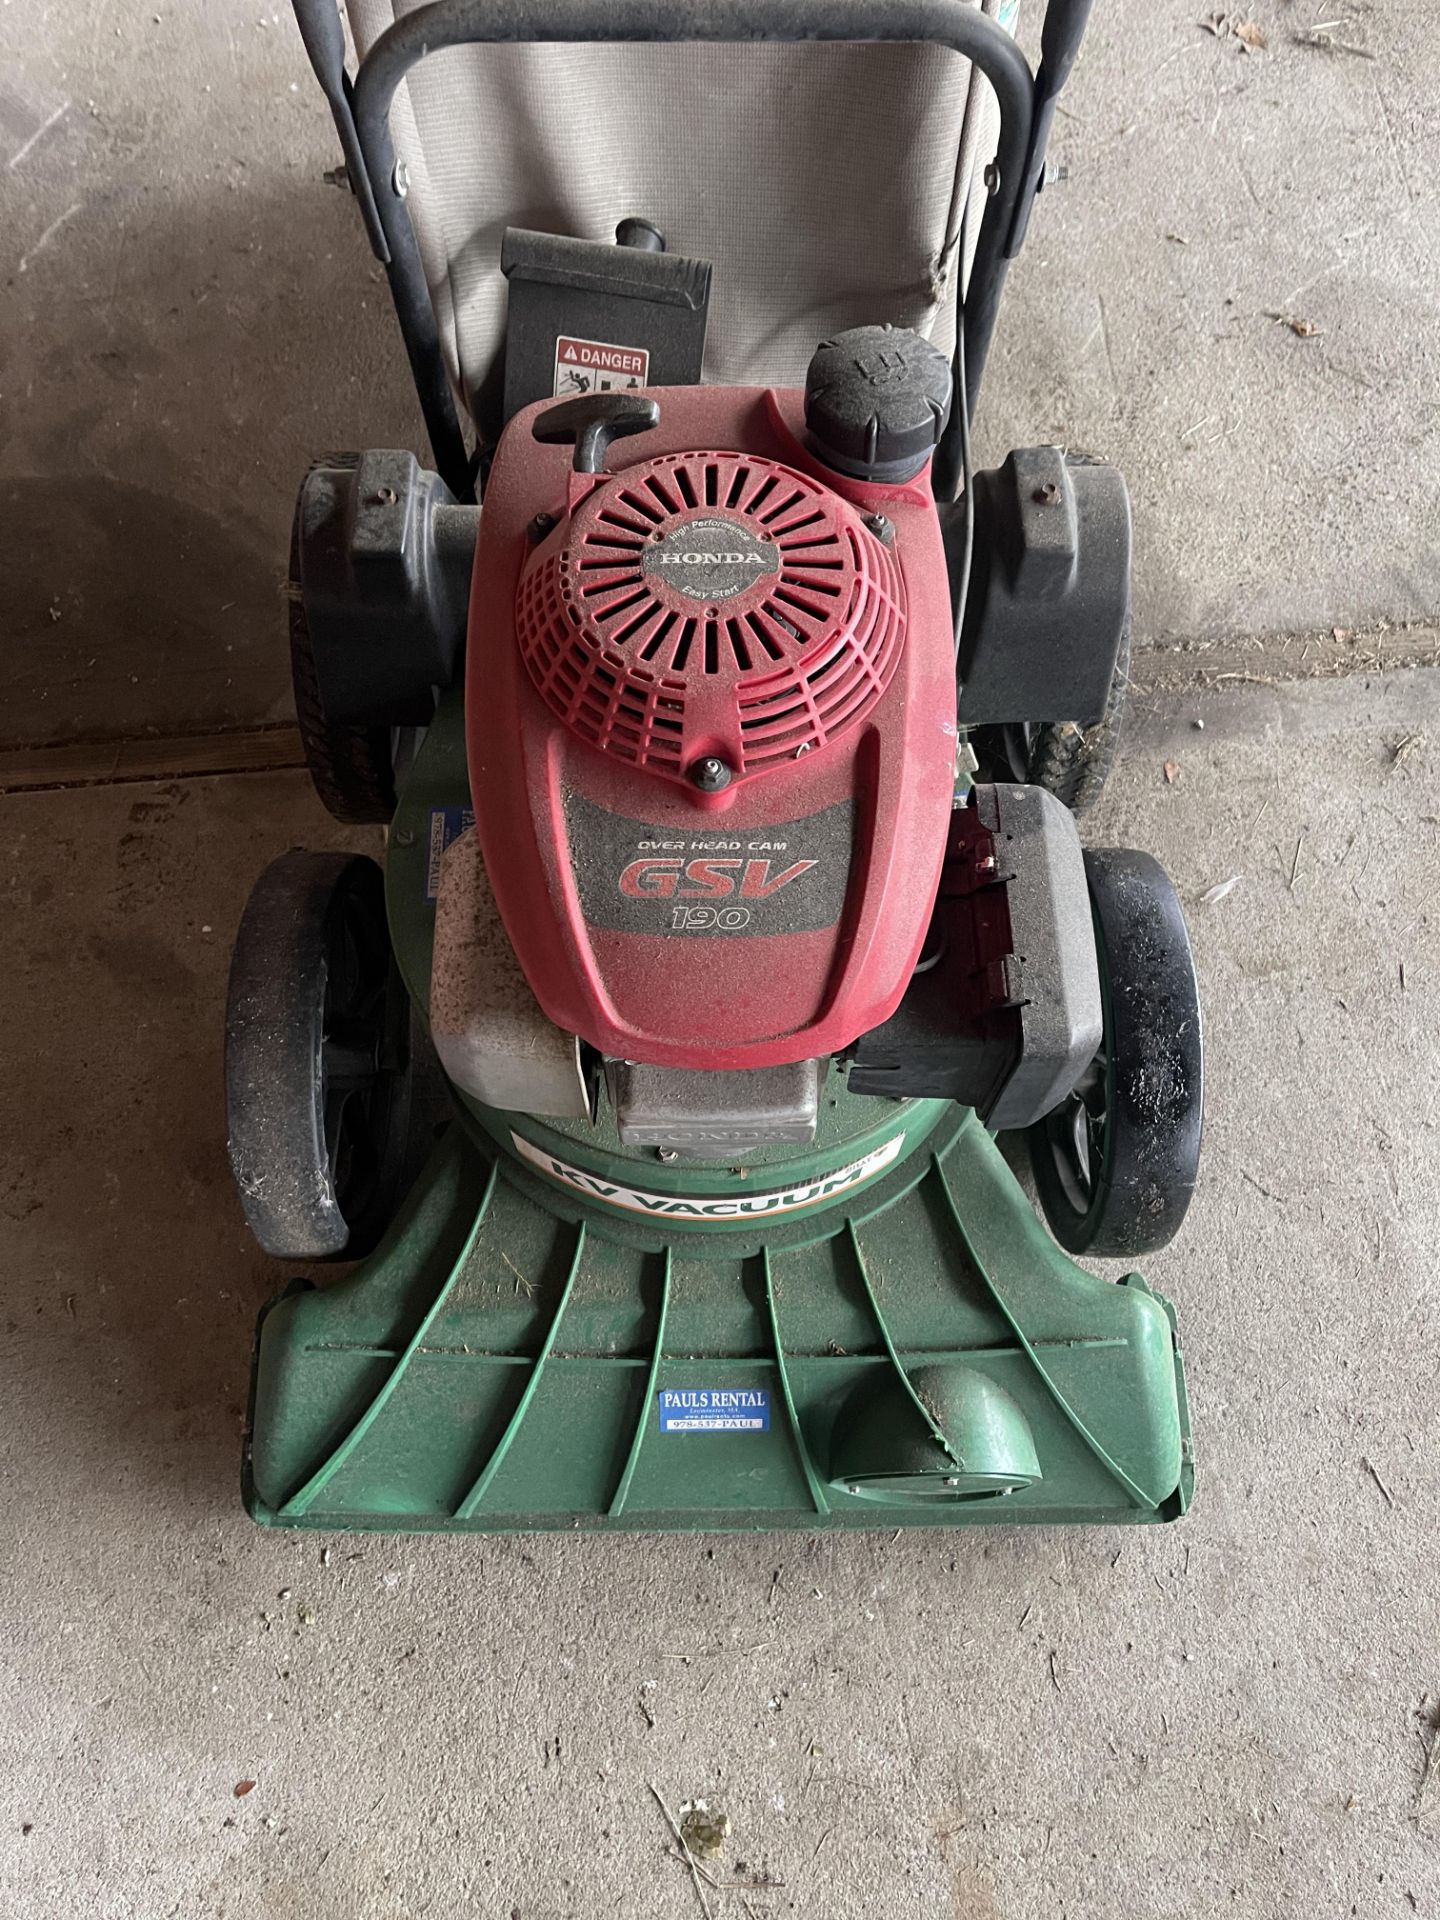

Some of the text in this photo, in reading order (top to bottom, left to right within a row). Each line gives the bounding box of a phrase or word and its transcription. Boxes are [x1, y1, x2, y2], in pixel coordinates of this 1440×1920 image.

[581, 348, 642, 371] DANGER
[669, 519, 750, 542] High Performance
[660, 552, 768, 564] HONDA
[682, 584, 739, 600] Easy Start
[637, 841, 787, 850] OVER HEAD CAM
[619, 858, 820, 898] GSV
[672, 906, 750, 929] 190
[551, 1160, 863, 1215] KV VACUUM
[664, 1392, 766, 1408] PAULS RENTAL
